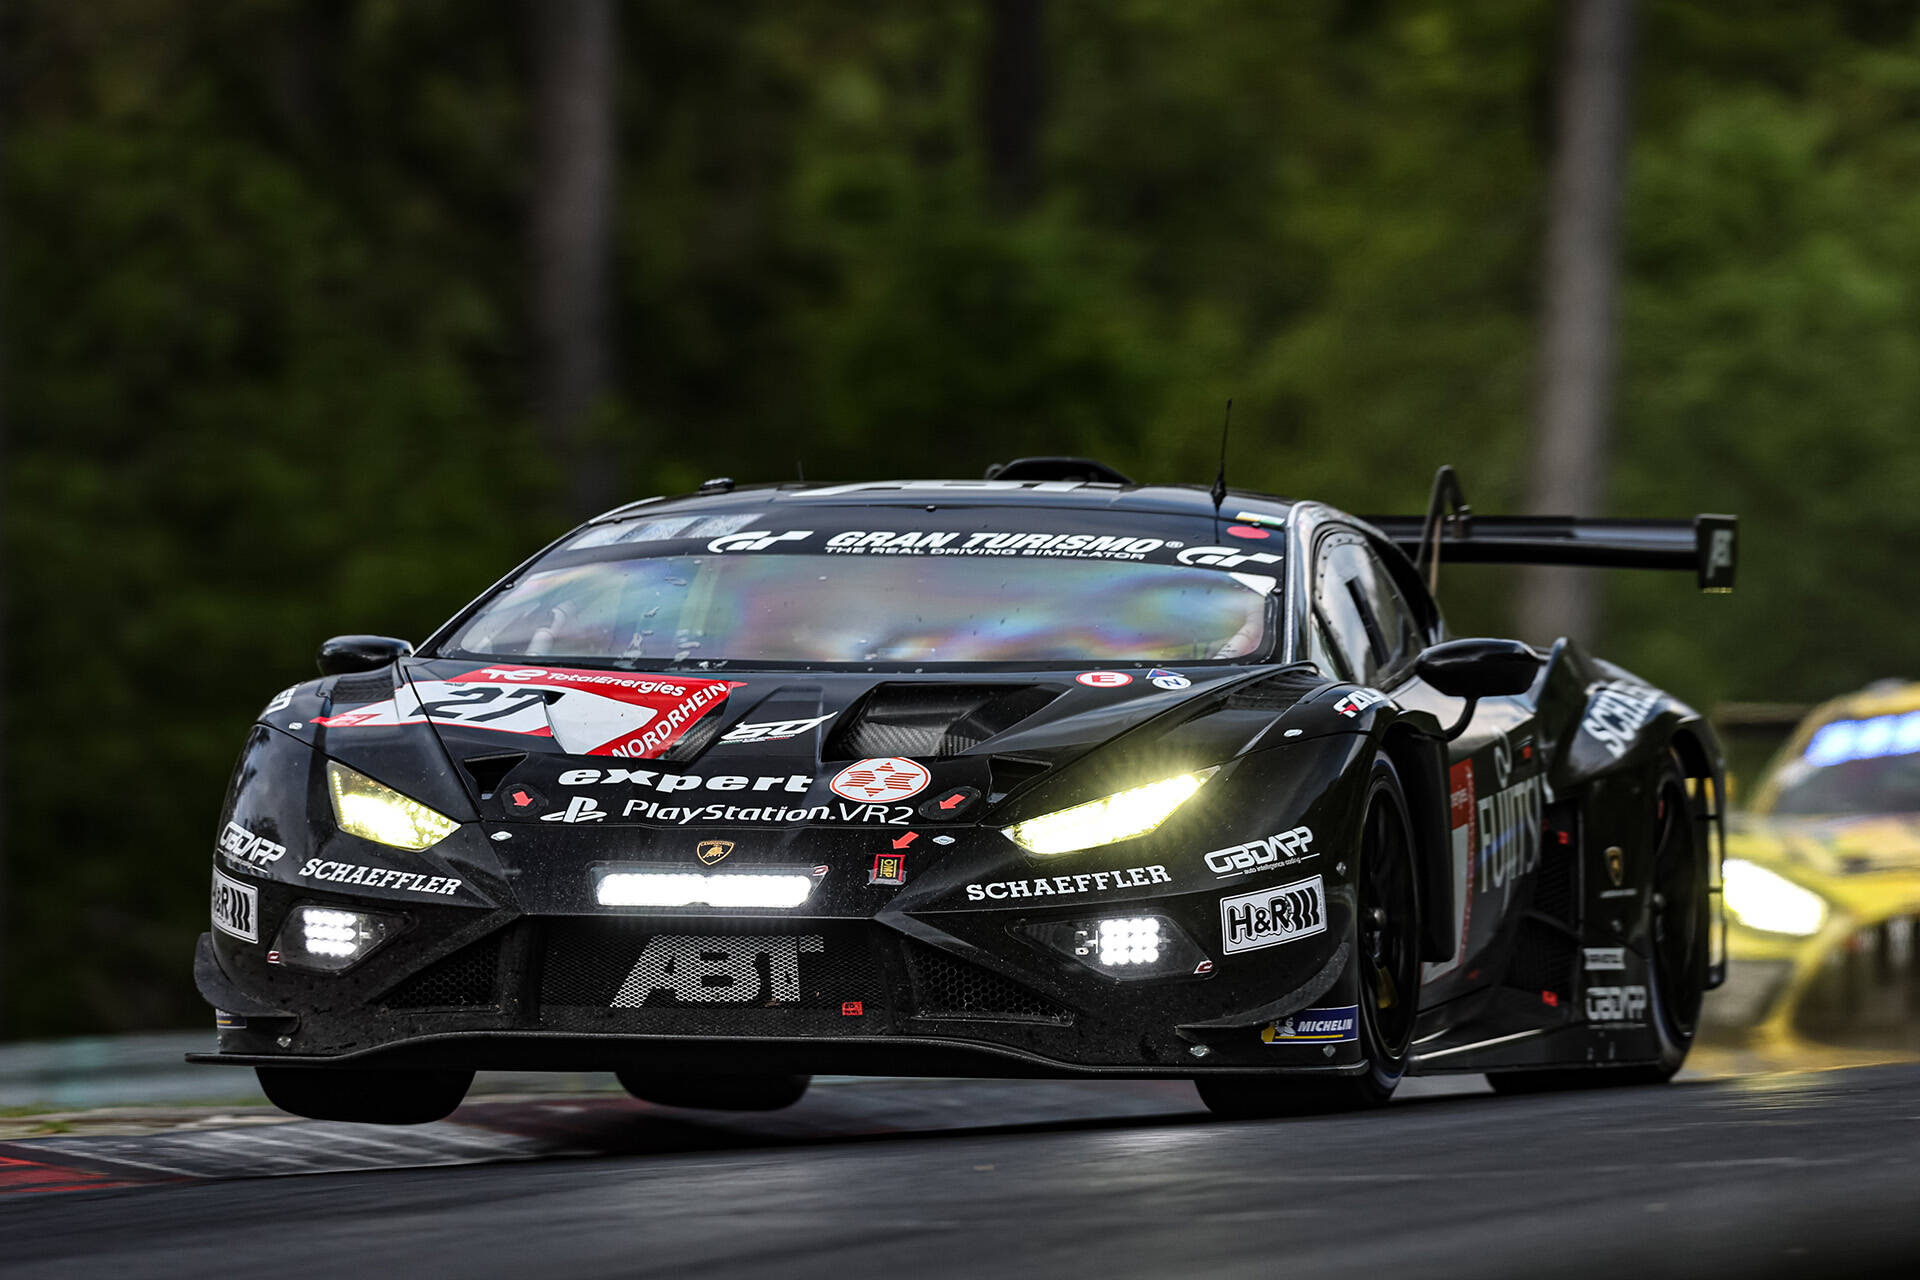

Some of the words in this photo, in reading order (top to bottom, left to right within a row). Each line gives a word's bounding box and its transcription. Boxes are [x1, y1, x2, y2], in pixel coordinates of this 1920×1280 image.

[824, 546, 866, 554] THE
[870, 546, 925, 555] REAL
[930, 547, 1017, 556] DRIVING
[1022, 548, 1146, 561] SIMULATOR
[826, 531, 960, 548] GRAN
[547, 671, 687, 697] TotalEnergies
[408, 686, 545, 723] 27
[611, 682, 728, 758] NORDRHEIN
[558, 768, 814, 794] expert
[298, 858, 463, 896] SCHAEFFLER
[883, 858, 894, 878] OMP
[966, 864, 1172, 901] SCHAEFFLER
[1228, 896, 1293, 943] H&R
[610, 934, 825, 1008] ABT
[1297, 1018, 1353, 1032] MICHELIN
